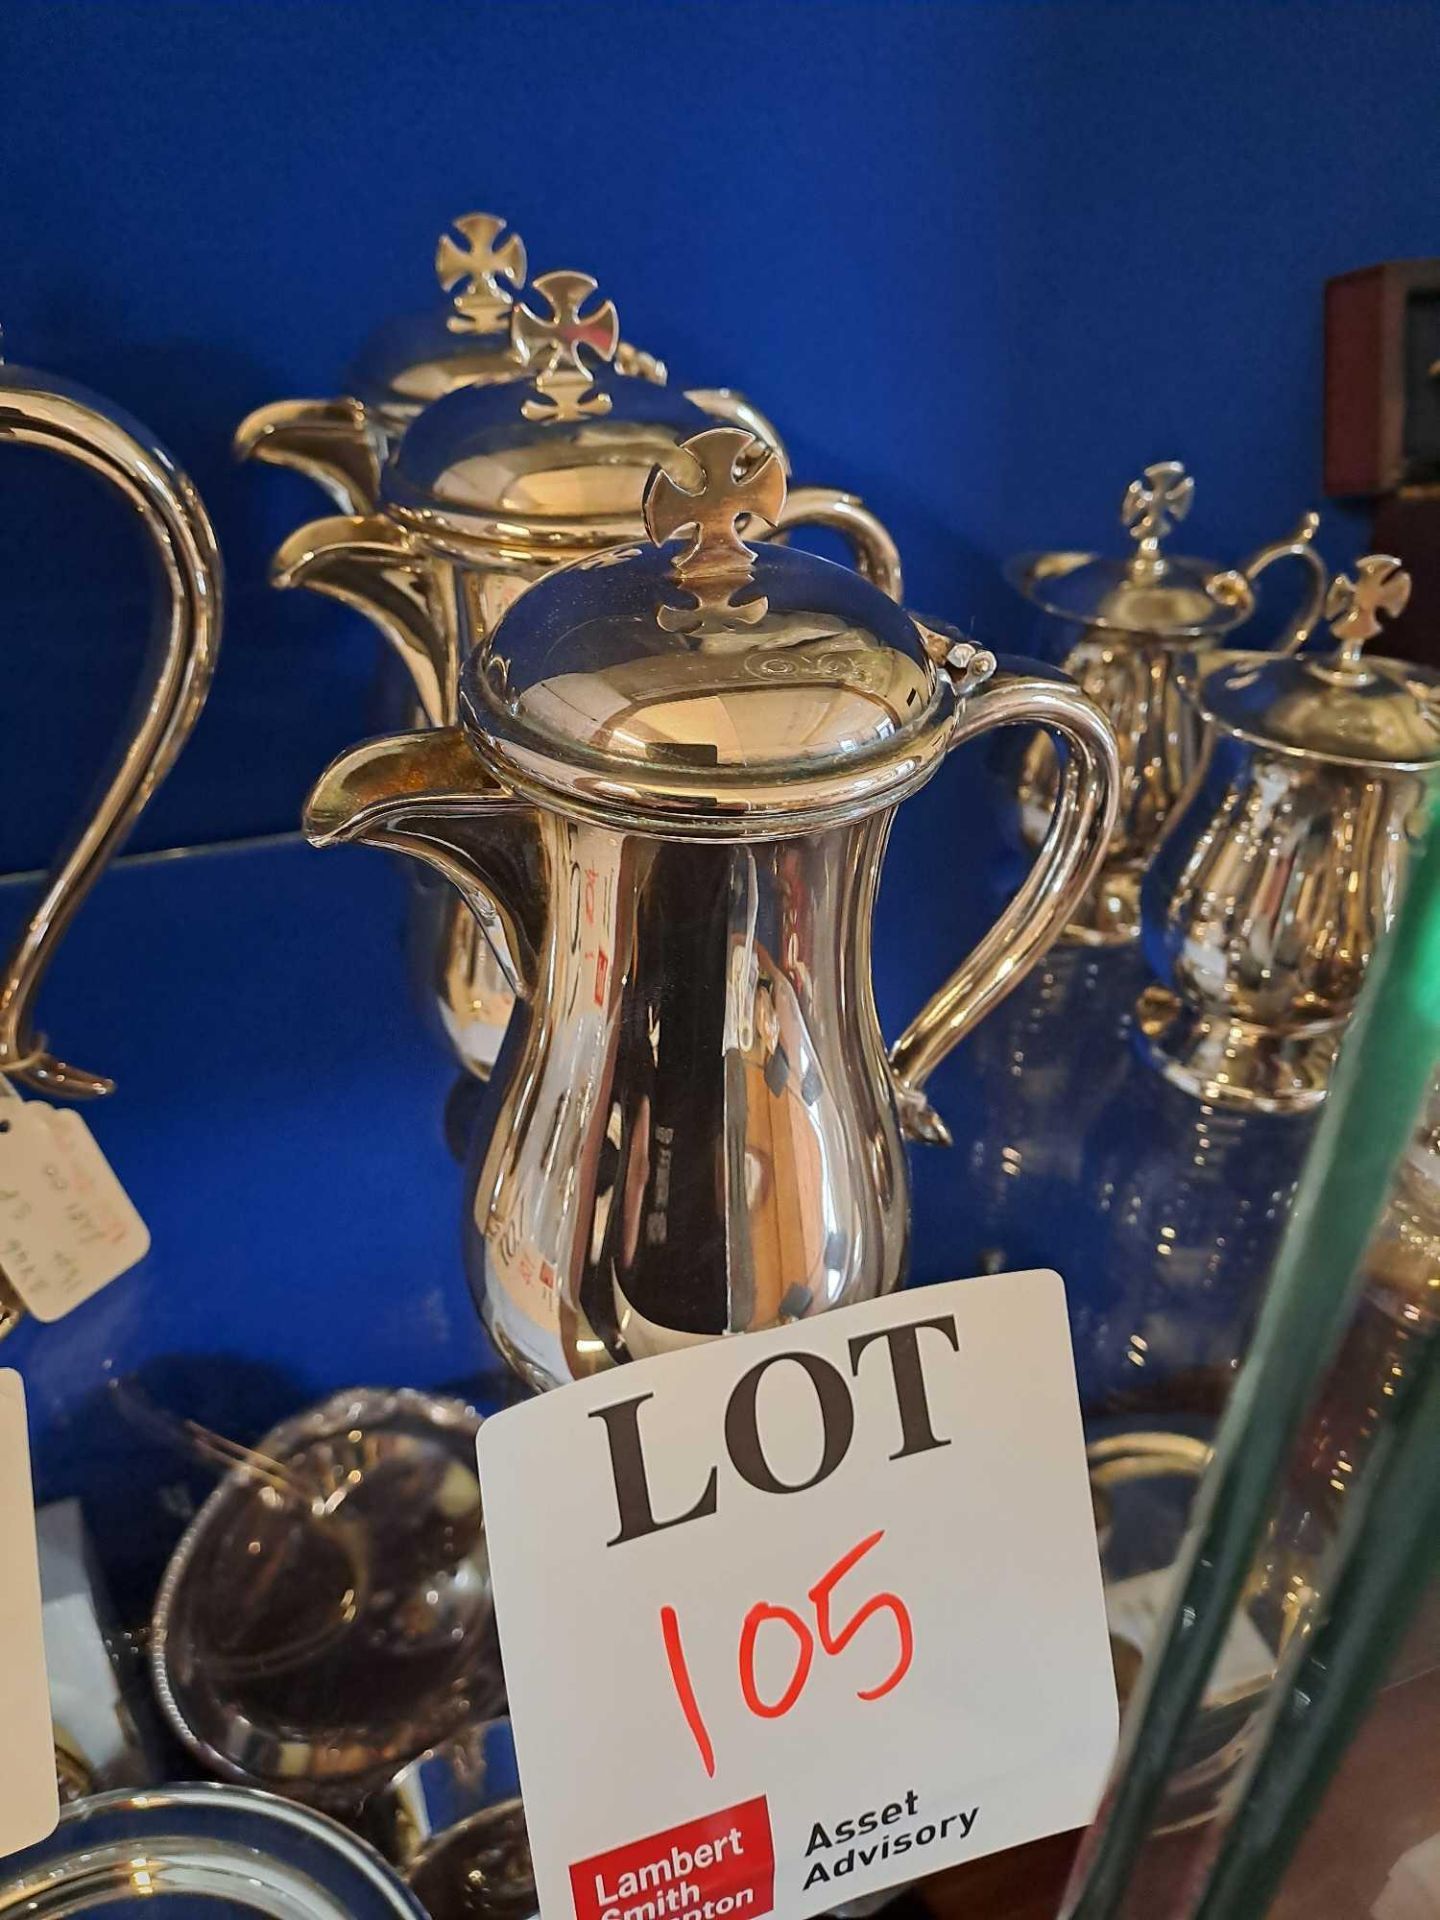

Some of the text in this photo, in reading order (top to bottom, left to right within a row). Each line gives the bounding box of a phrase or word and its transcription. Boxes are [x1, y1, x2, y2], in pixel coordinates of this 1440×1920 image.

[587, 1314, 960, 1548] LOT
[660, 1529, 914, 1778] 105
[802, 1806, 979, 1891] Advisory
[804, 1789, 919, 1857] Asset
[594, 1827, 744, 1907] Lambert
